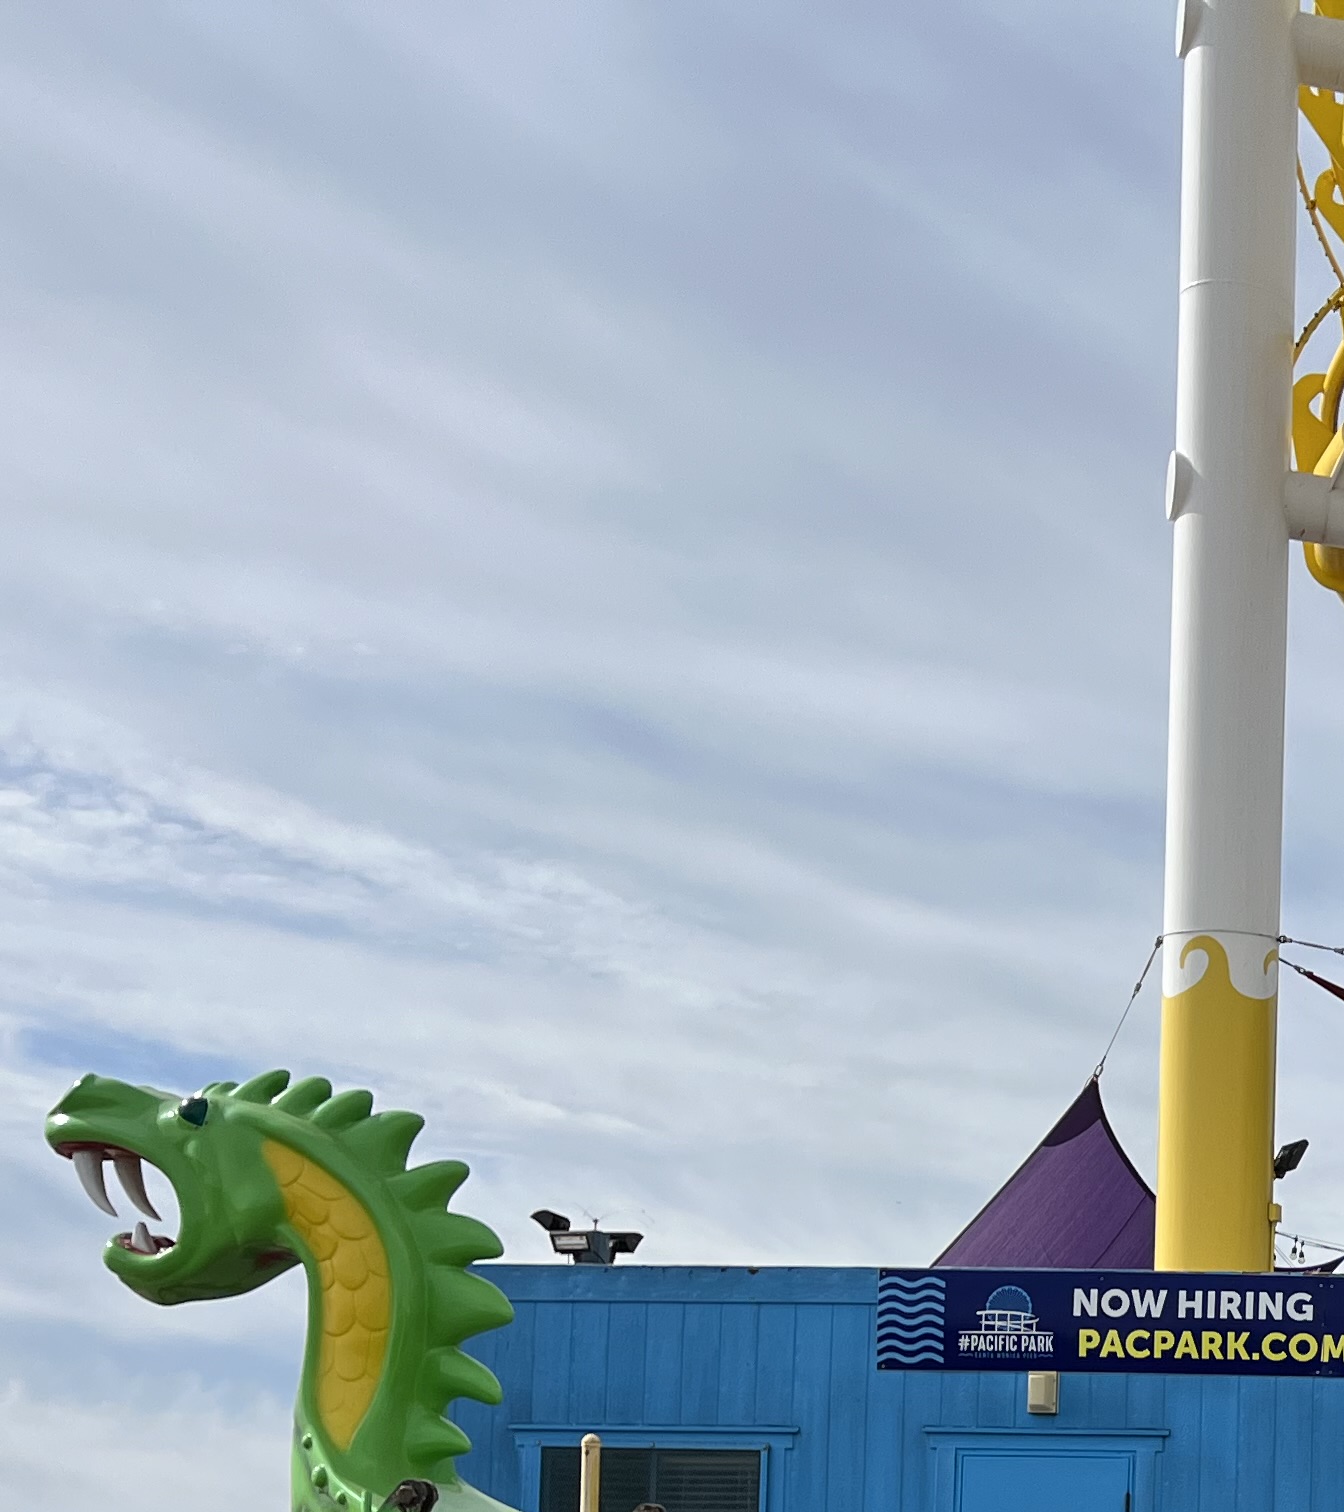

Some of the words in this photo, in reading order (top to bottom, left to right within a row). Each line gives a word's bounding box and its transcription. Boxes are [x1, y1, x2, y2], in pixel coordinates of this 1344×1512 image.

[1073, 1289, 1168, 1318] NOW
[1178, 1291, 1314, 1321] HIRING
[957, 1334, 1018, 1352] #PACIFIC
[1021, 1335, 1054, 1352] PARK
